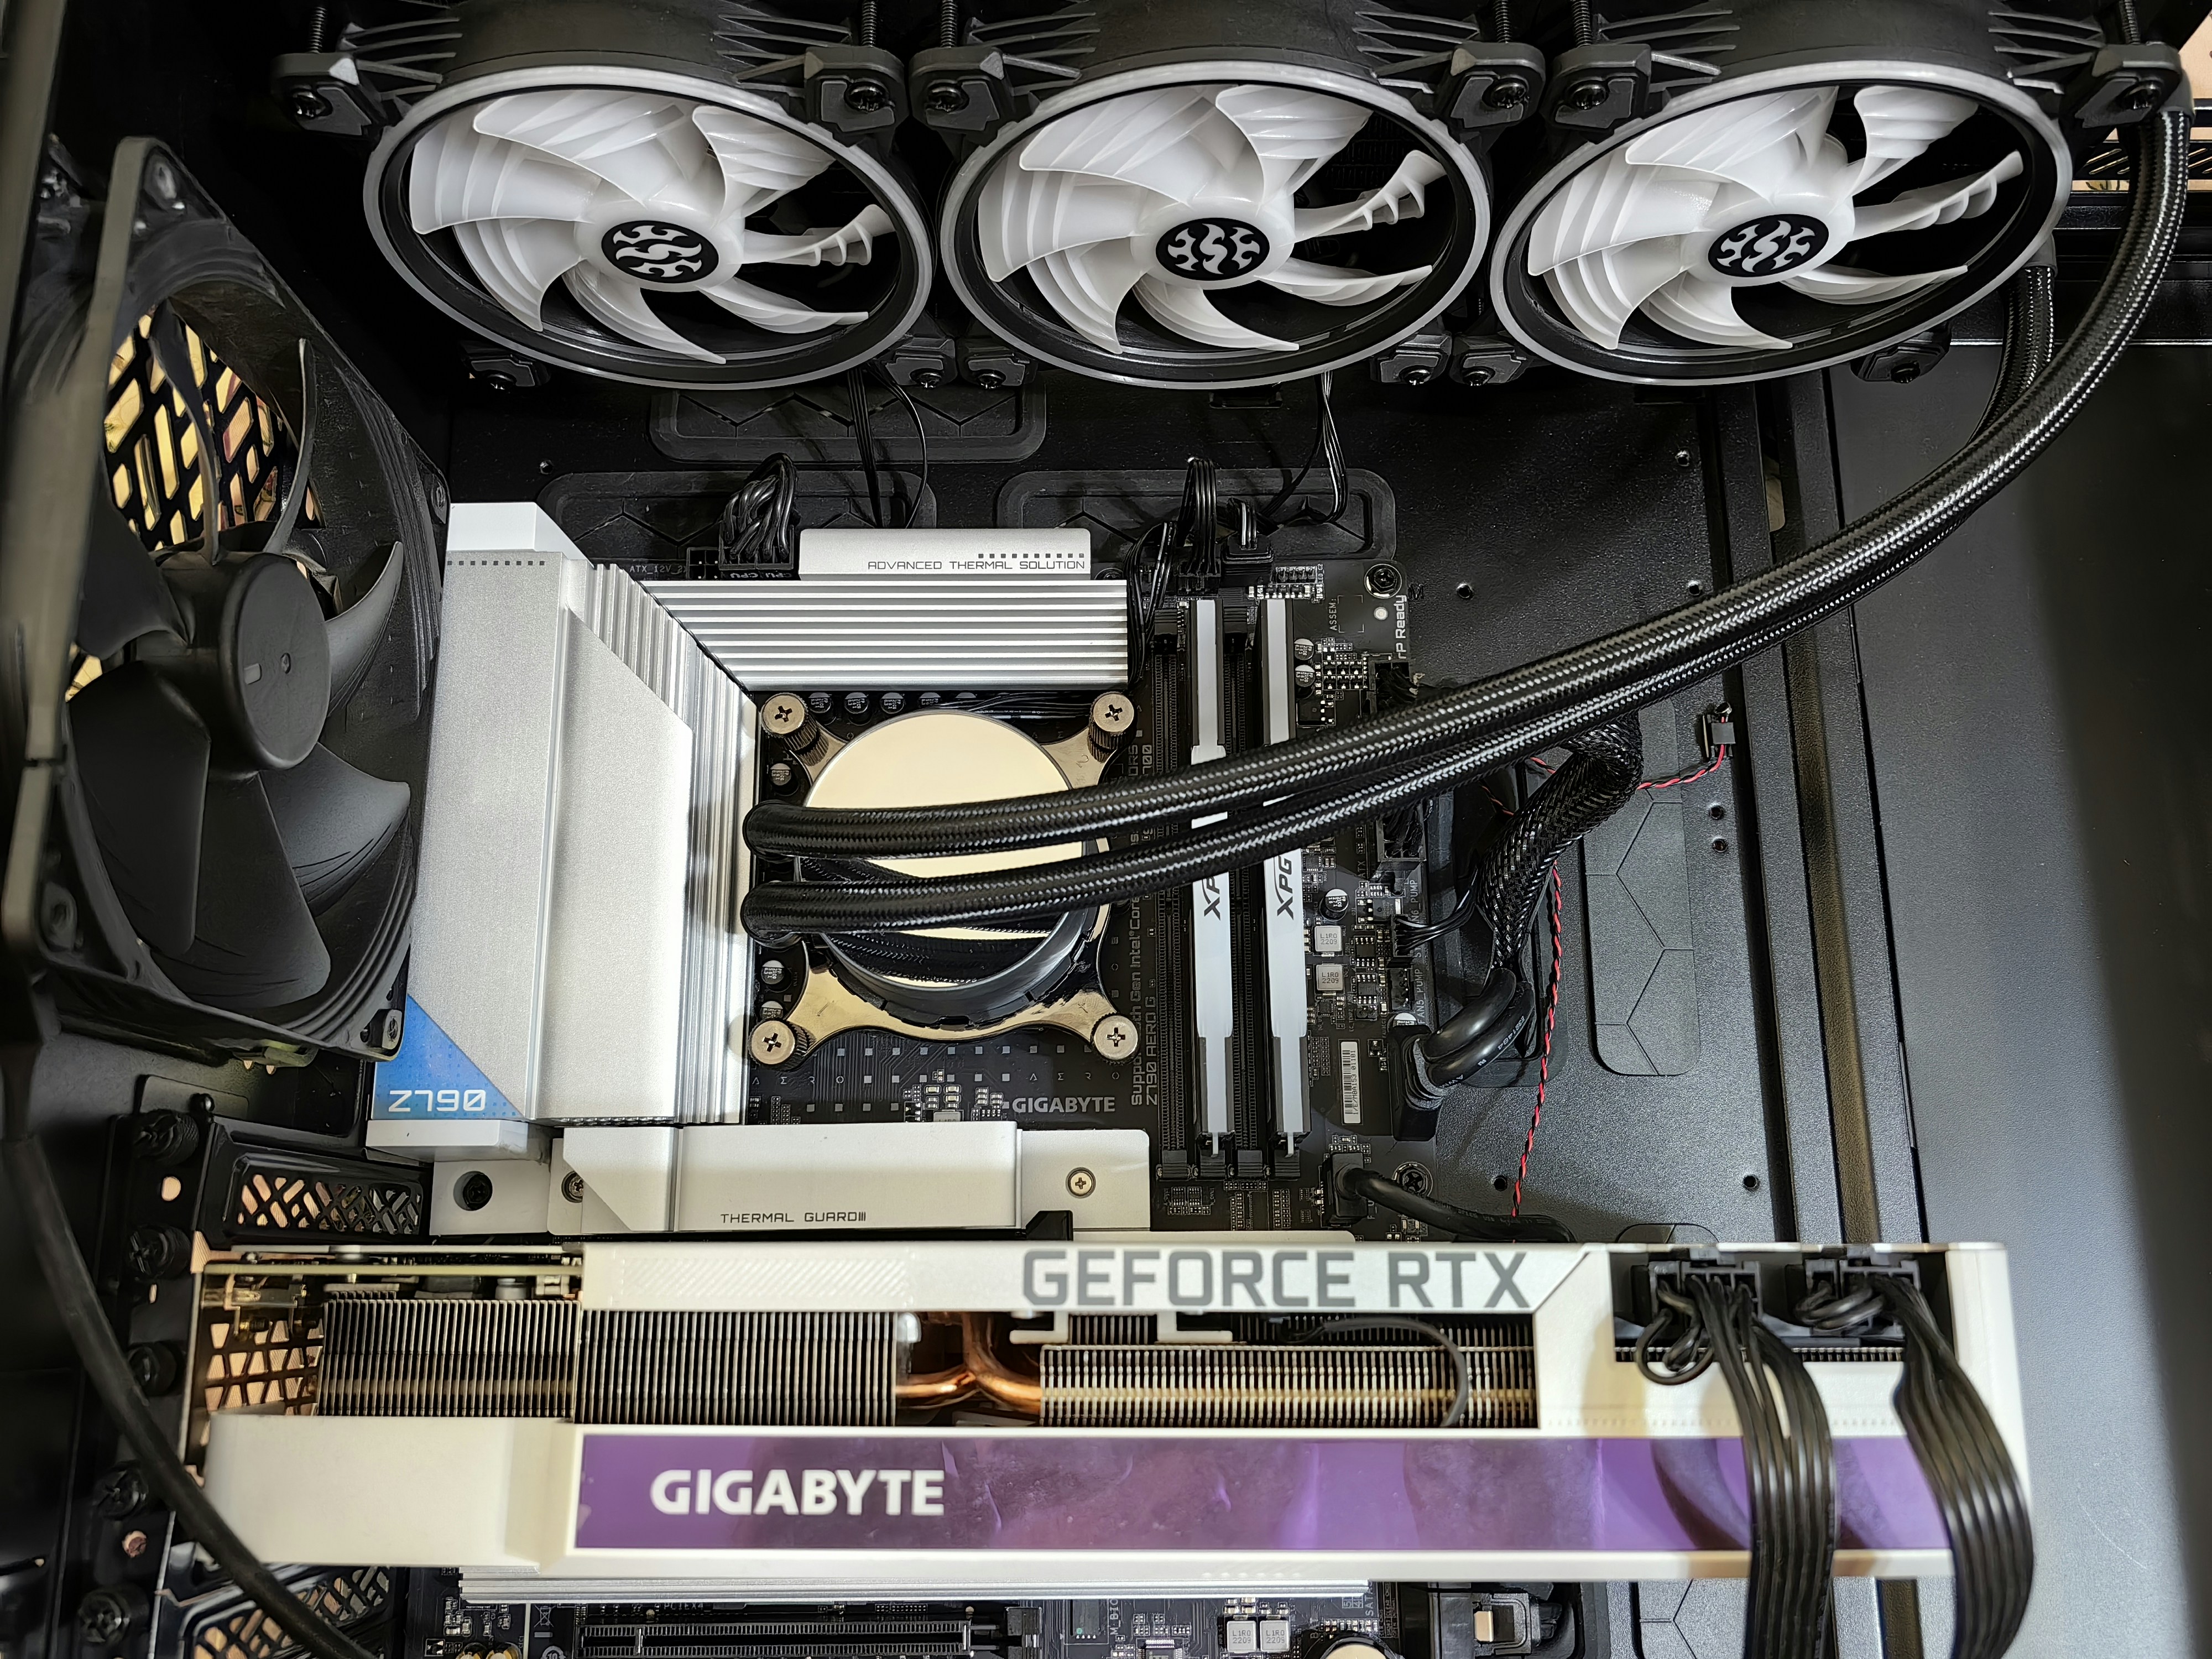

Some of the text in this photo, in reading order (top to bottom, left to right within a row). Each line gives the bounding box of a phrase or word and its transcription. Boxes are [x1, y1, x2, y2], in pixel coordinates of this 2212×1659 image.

[629, 564, 687, 575] ATX_12V_2X
[868, 560, 1085, 570] ADVANCED THERMAL SOLUTION
[1328, 598, 1338, 631] ASSEM:
[1394, 594, 1407, 659] rP Ready
[1357, 860, 1366, 878] ATX
[1203, 877, 1221, 921] XP
[1276, 855, 1294, 921] XPG
[1130, 972, 1141, 1001] Gen
[1145, 997, 1158, 1105] Z790 AERO G
[1131, 1051, 1145, 1105] Suppo
[388, 1089, 486, 1113] Z790
[1011, 1096, 1116, 1114] GIGABYTE
[720, 1212, 795, 1223] THERMAL
[1022, 1249, 1531, 1310] GEFORCE RTX
[650, 1469, 945, 1516] GIGABYTE
[1109, 1599, 1121, 1635] M_BIO
